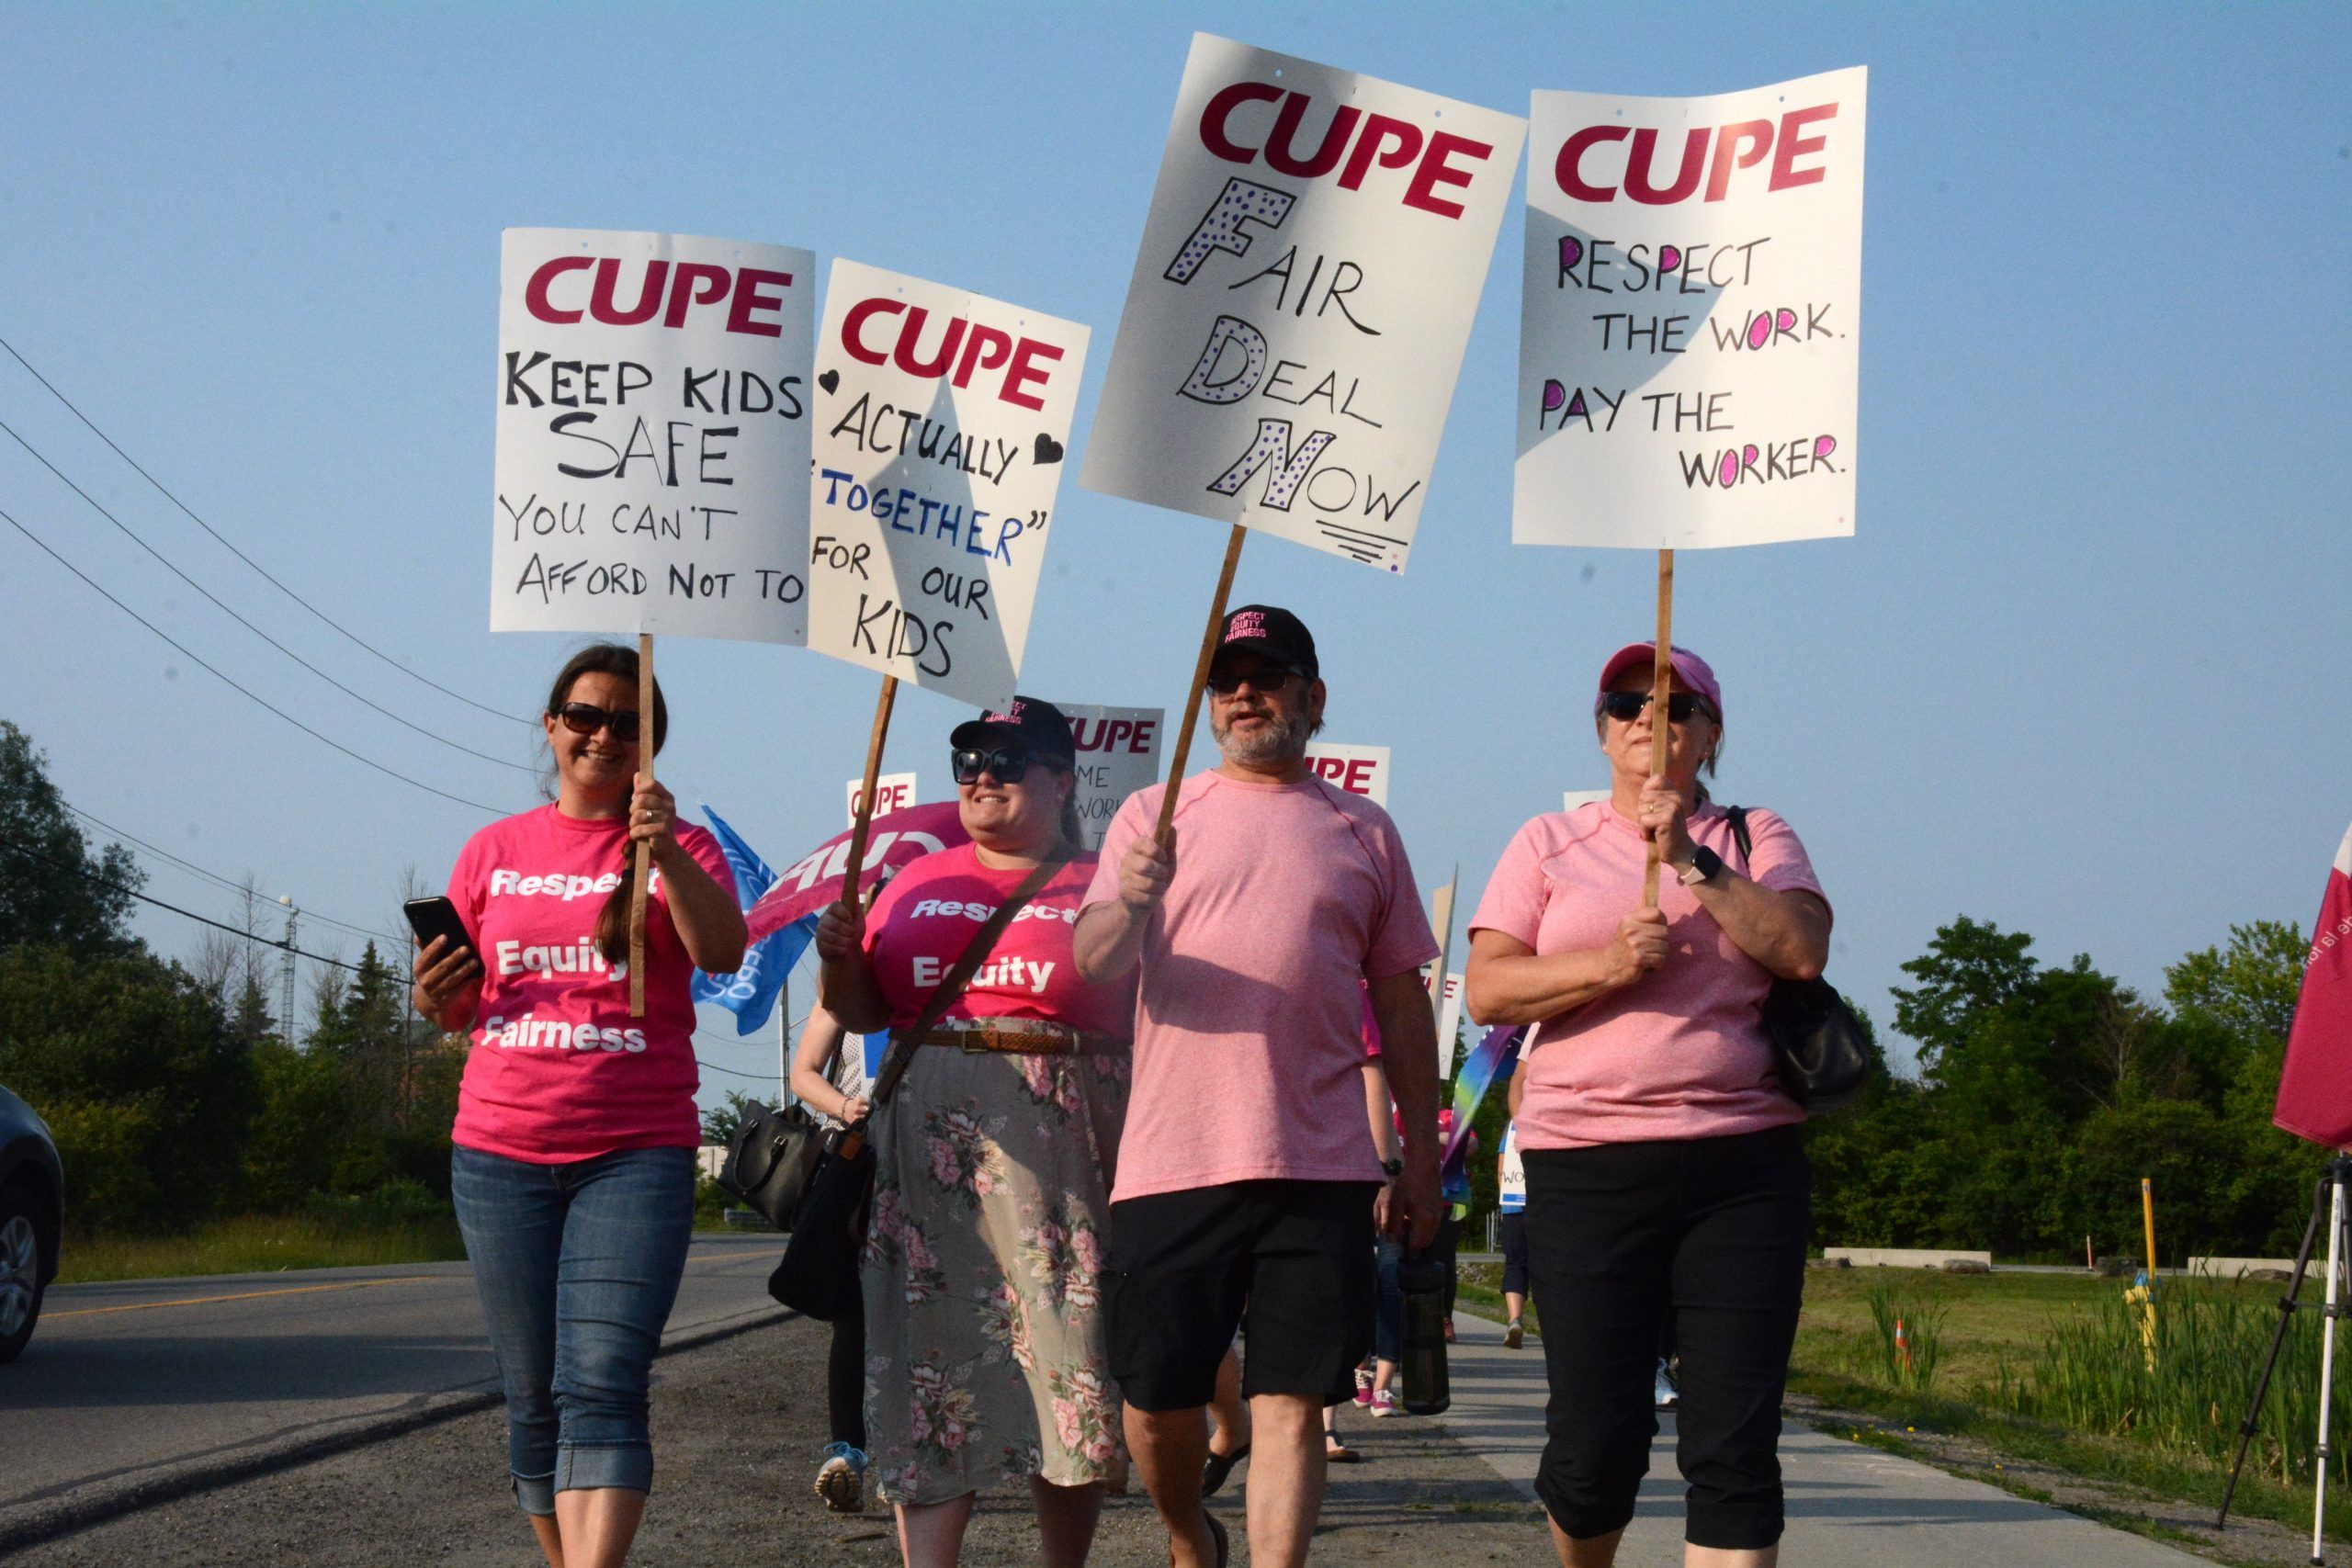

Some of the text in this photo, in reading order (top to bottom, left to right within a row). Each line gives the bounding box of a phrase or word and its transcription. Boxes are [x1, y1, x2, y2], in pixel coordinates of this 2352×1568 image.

[1199, 81, 1494, 220] CUPE
[1555, 101, 1839, 206] CUPE
[1558, 235, 1771, 294] RESPECT
[525, 255, 793, 338] CUPE
[841, 298, 1065, 412] CUPE
[1592, 303, 1846, 355] THE WORK.
[504, 351, 803, 420] KEEP KIDS
[1540, 378, 1734, 433] PAY THE
[549, 412, 739, 487] SAFE
[830, 393, 1018, 487] ACTUALLY
[1679, 434, 1847, 490] WORKER.
[499, 494, 738, 542] YOU CAN'T
[515, 553, 804, 604] AFFORD NOT TO
[812, 536, 989, 620] FOR OUR
[852, 593, 955, 677] KIDS
[1225, 627, 1267, 644] FAIRNESS
[1064, 716, 1156, 753] UPE
[852, 784, 908, 818] CPE
[1305, 757, 1377, 795] PE
[491, 868, 660, 901] Respet
[910, 899, 1079, 924] Resect
[913, 956, 1056, 993] Euity
[481, 1013, 647, 1053] Fairness
